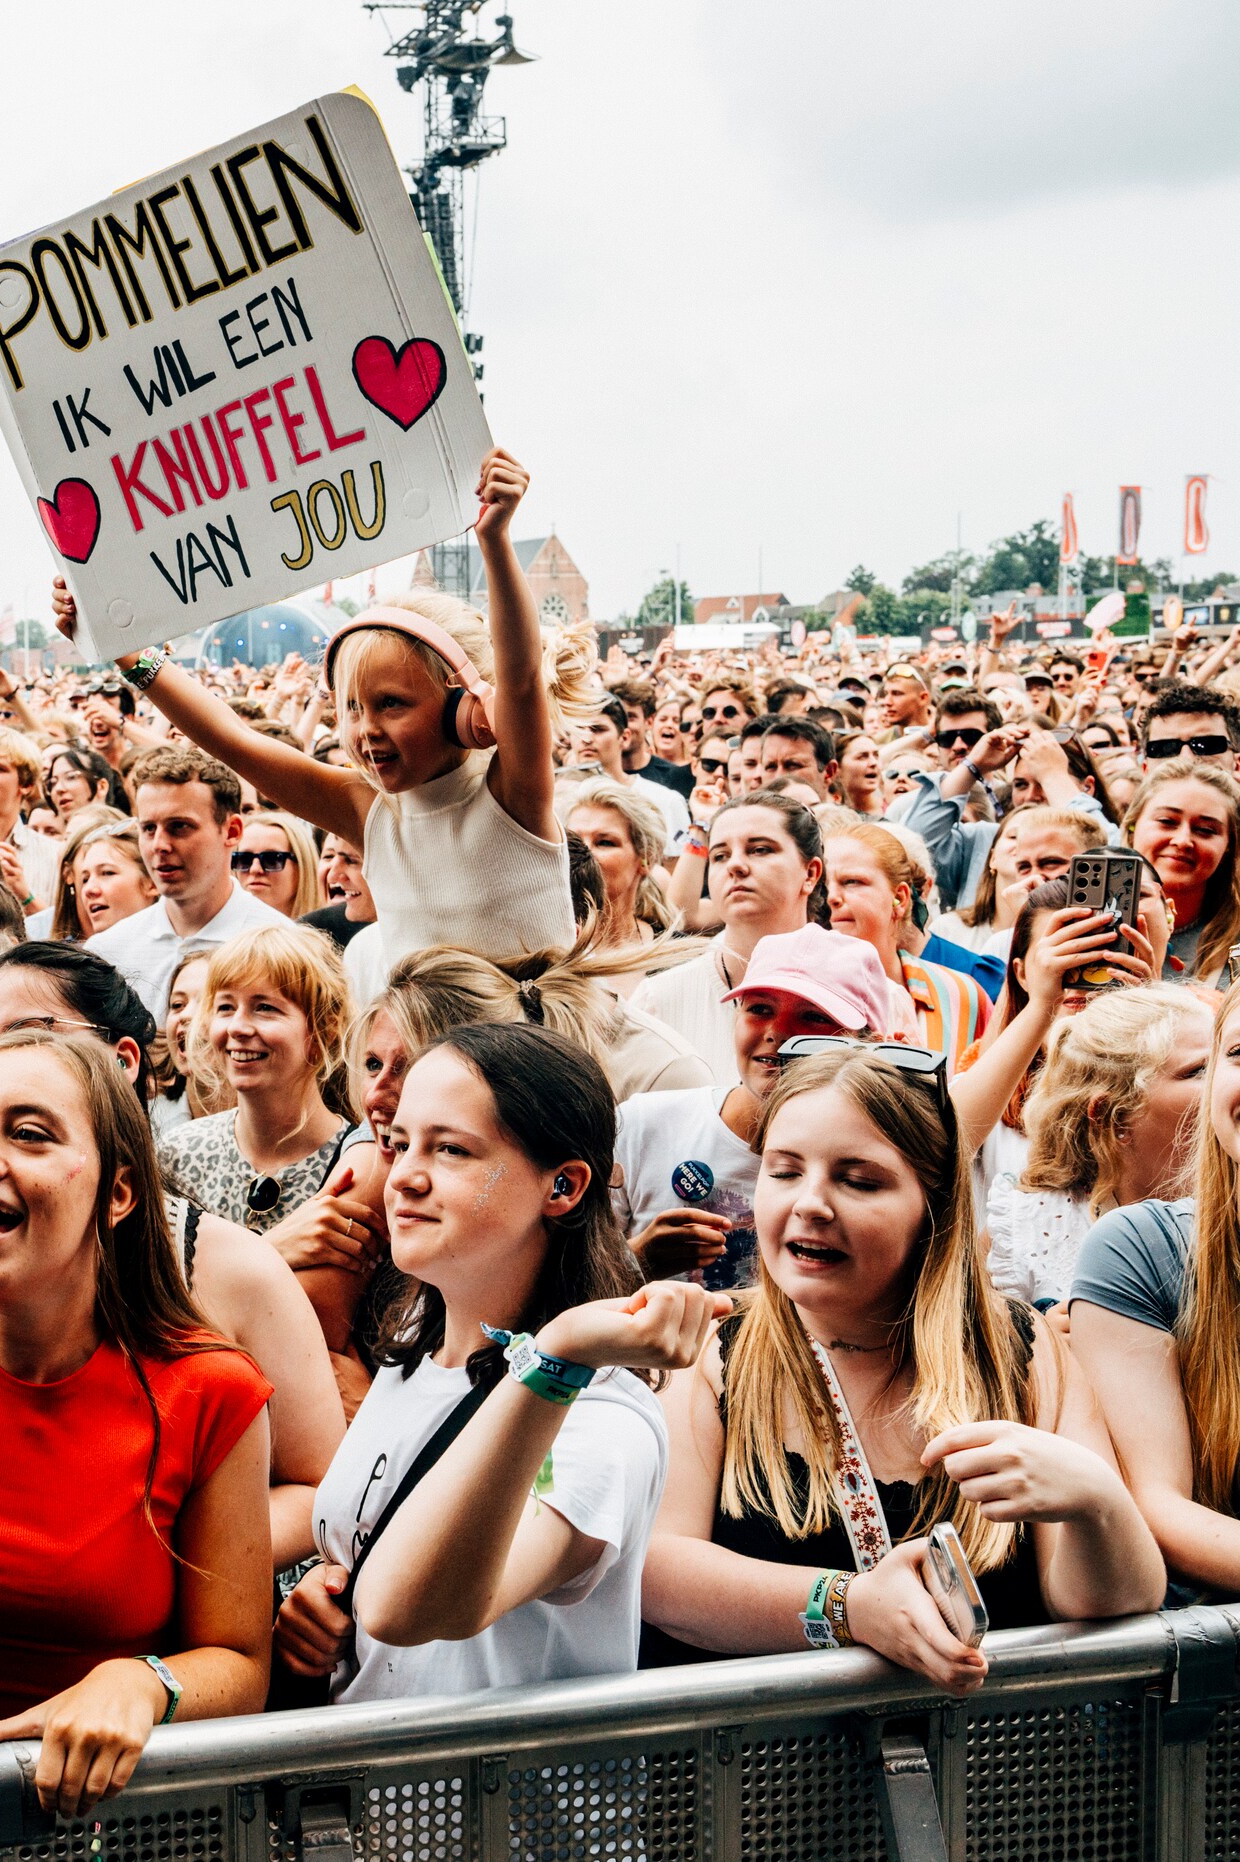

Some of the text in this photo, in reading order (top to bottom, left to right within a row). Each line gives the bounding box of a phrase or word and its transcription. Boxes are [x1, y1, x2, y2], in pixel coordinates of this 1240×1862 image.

[52, 277, 313, 453] IK WIL EEN
[111, 363, 367, 533] KNUFFEL
[150, 460, 386, 604] VAN JOU
[679, 1163, 698, 1184] HERE
[696, 1182, 708, 1197] WE
[680, 1177, 695, 1193] GO!
[540, 1359, 562, 1374] SAT
[833, 1572, 853, 1621] WE ARE
